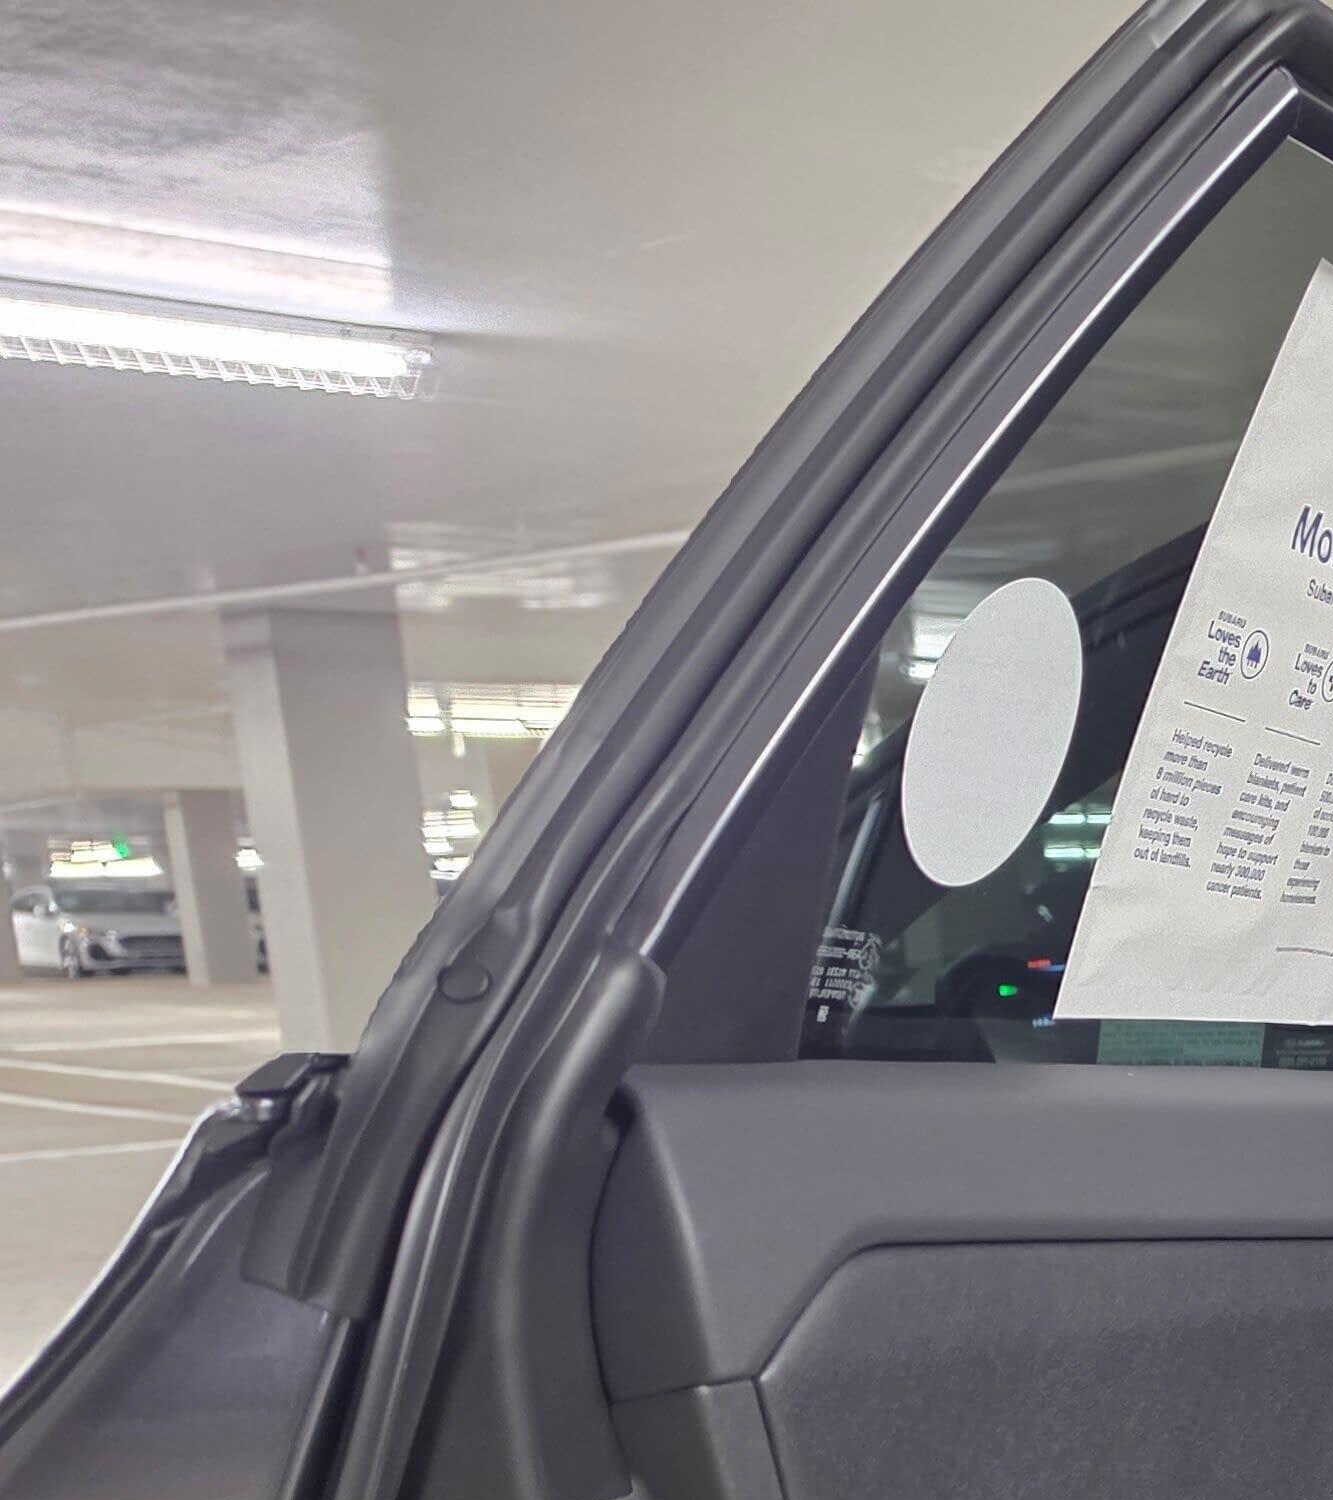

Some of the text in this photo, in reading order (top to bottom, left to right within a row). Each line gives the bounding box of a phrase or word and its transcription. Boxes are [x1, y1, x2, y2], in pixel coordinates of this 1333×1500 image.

[1219, 611, 1246, 628] SUBARU
[1208, 621, 1241, 648] Loves
[1218, 647, 1236, 666] the
[1295, 654, 1323, 678] Loves
[1198, 661, 1230, 684] Earth
[1307, 679, 1316, 694] to
[1289, 690, 1313, 710] Care
[1172, 729, 1232, 757] Helped recycle
[1164, 752, 1208, 771] more than
[1254, 753, 1309, 778] Delivered warm
[1157, 767, 1221, 795] 8 million pieces
[1247, 771, 1306, 797] blankets, patient
[1151, 787, 1189, 806] of hard to
[1240, 793, 1257, 804] care
[1274, 800, 1290, 811] and
[1143, 809, 1198, 831] recycle waste,
[1232, 810, 1280, 831] encouraging
[1139, 824, 1191, 847] keeping them
[1223, 827, 1275, 845] messages of
[1134, 848, 1190, 867] out of landfills.
[1216, 842, 1278, 865] hope to support
[1211, 863, 1235, 878] nearly
[1207, 882, 1261, 899] cancer patients.
